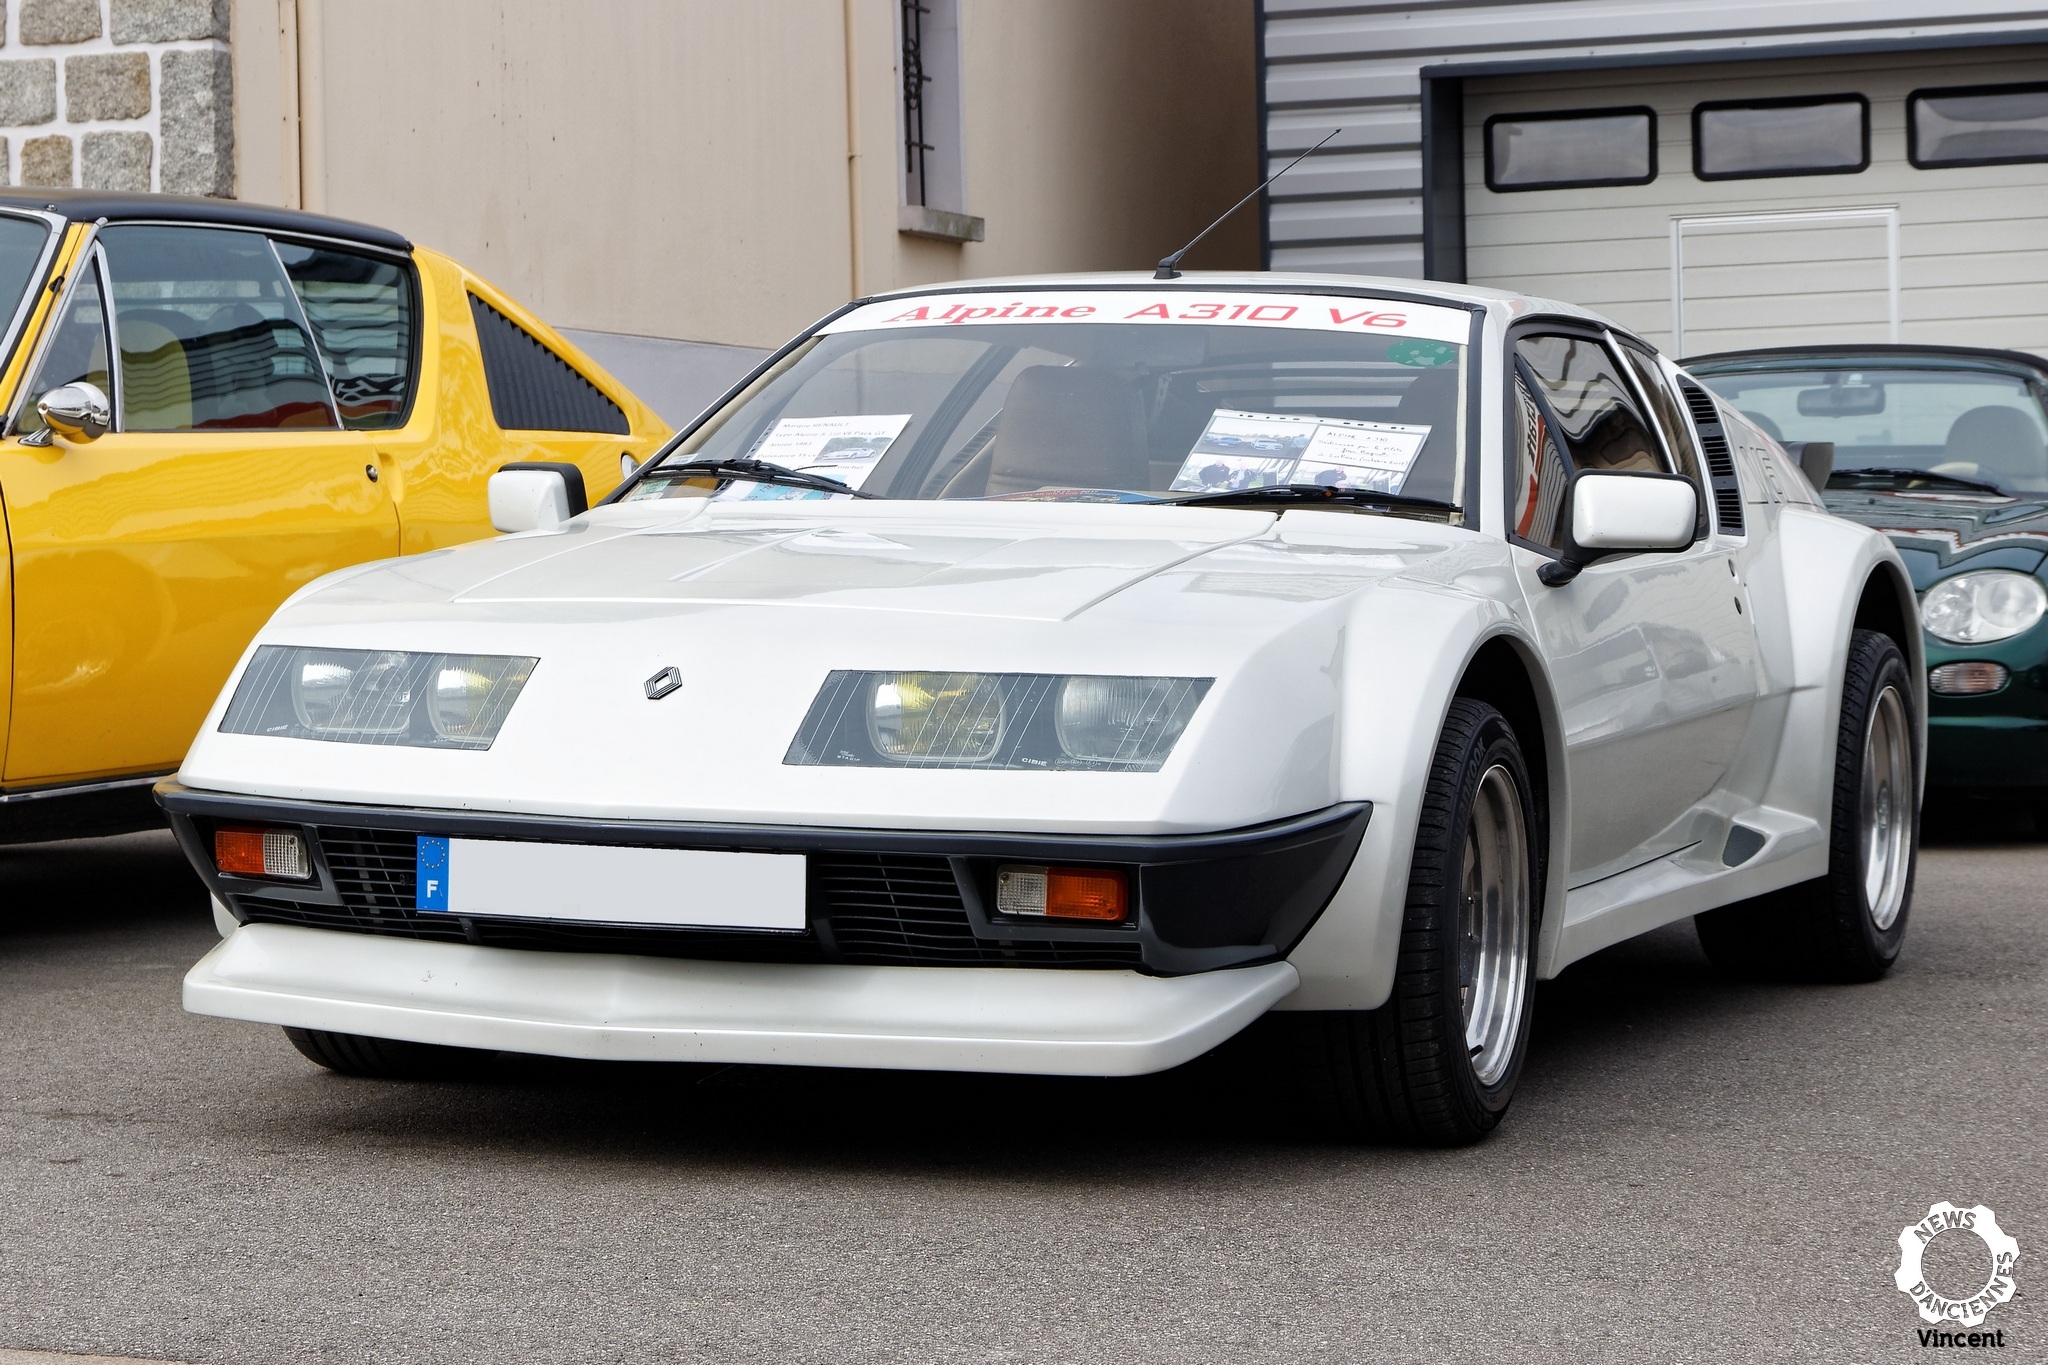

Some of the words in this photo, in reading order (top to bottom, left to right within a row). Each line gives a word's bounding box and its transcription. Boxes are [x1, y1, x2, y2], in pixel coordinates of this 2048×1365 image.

[882, 302, 1097, 324] Alpine
[1123, 303, 1300, 321] A310
[1328, 308, 1407, 328] V6
[426, 880, 439, 898] F
